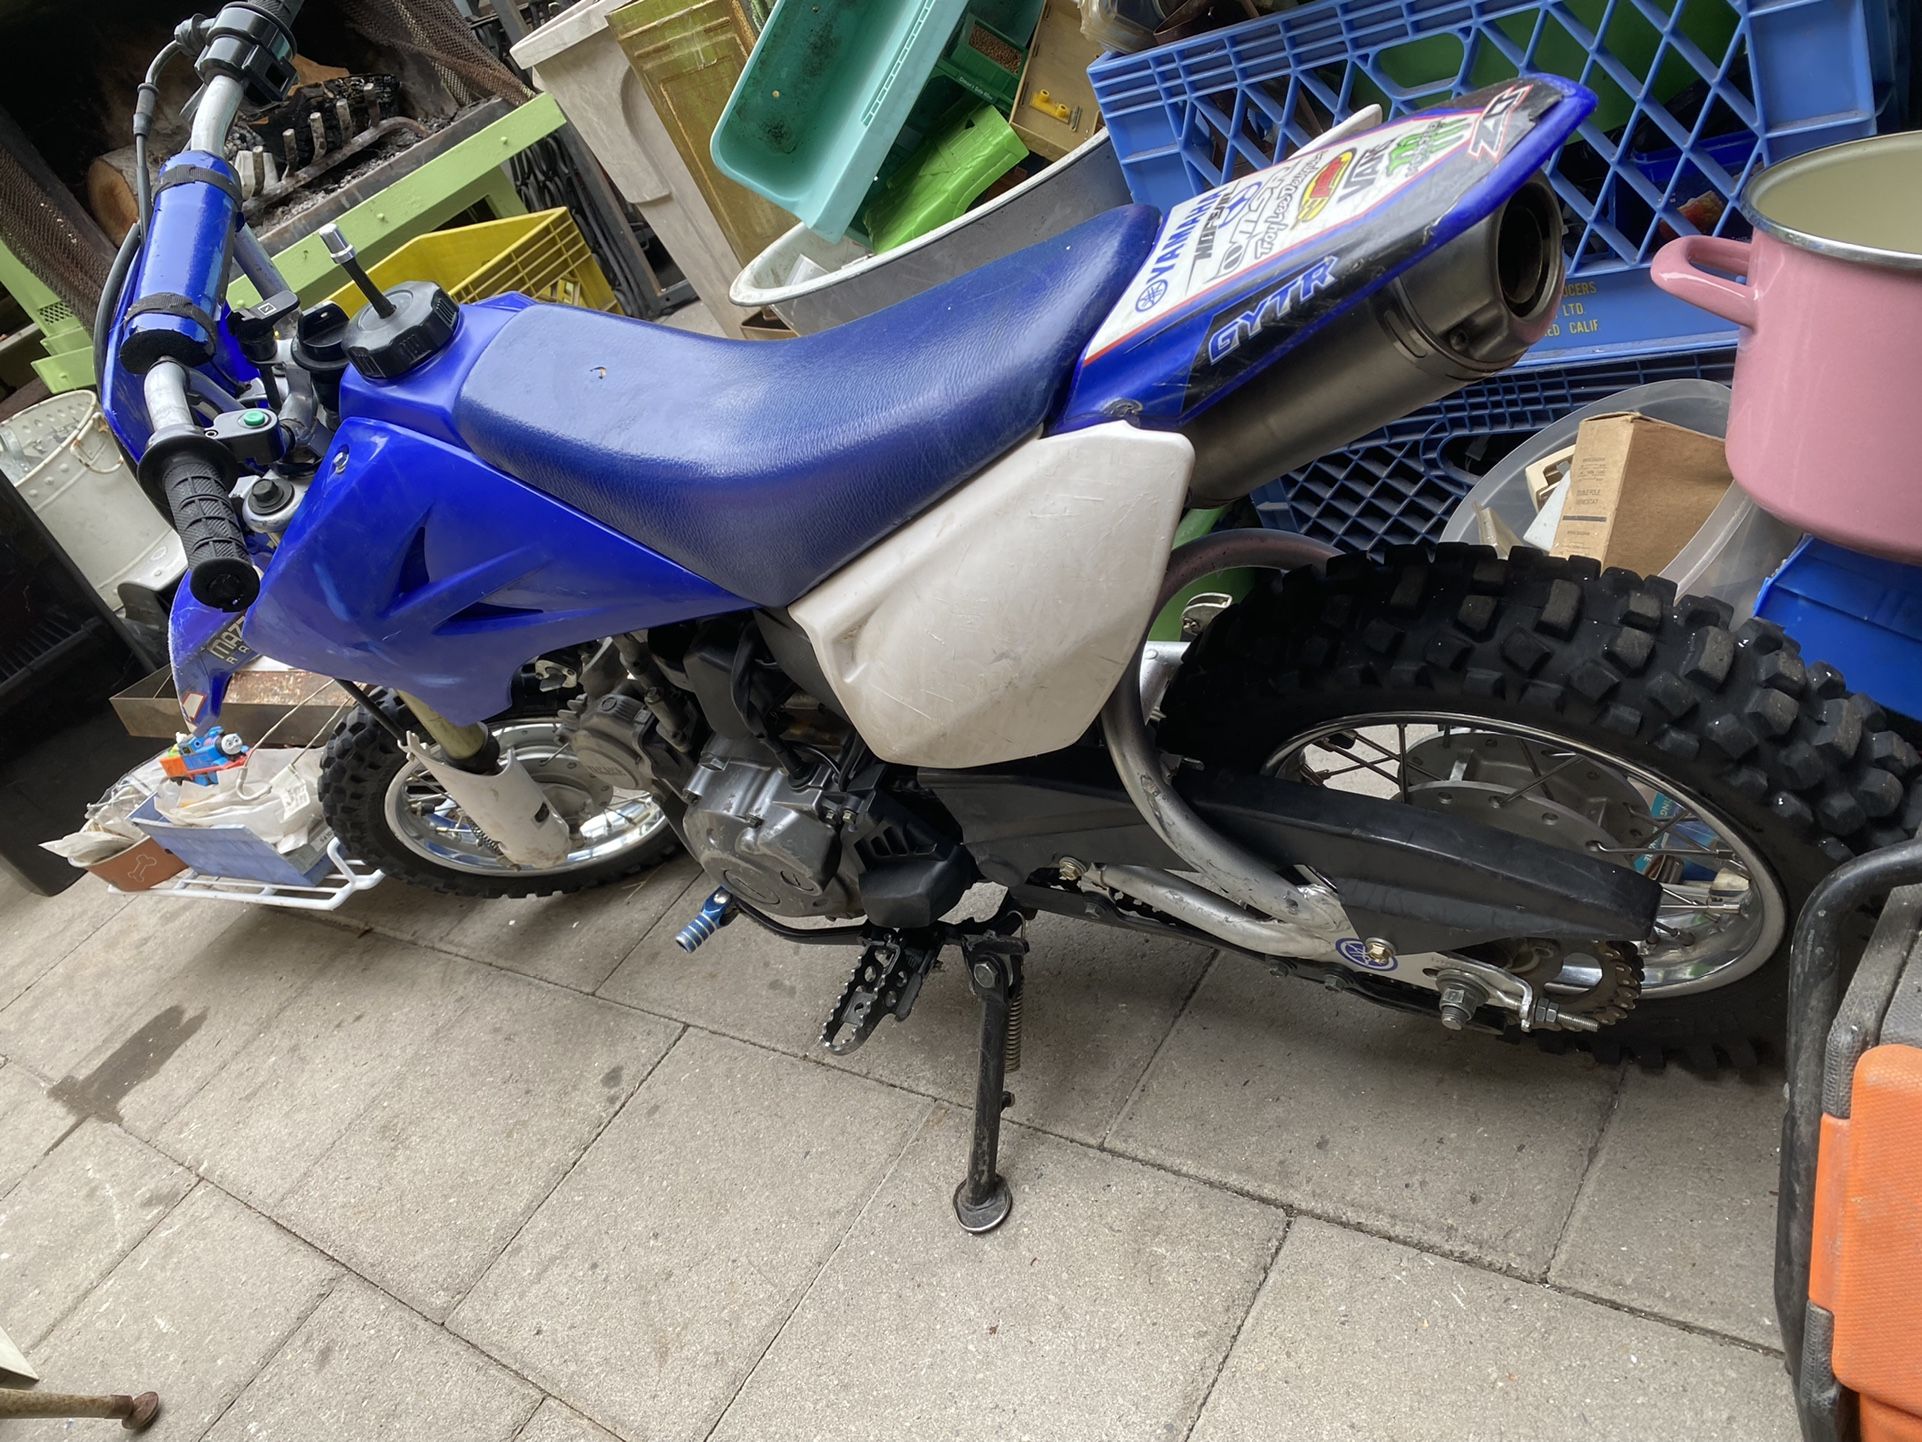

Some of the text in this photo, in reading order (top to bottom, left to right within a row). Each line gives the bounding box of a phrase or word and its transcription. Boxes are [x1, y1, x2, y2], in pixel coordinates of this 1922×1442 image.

[1146, 187, 1229, 284] YAMAHA
[1209, 255, 1338, 365] GYTR
[1563, 281, 1597, 297] UCERS
[1569, 320, 1598, 334] CALIF
